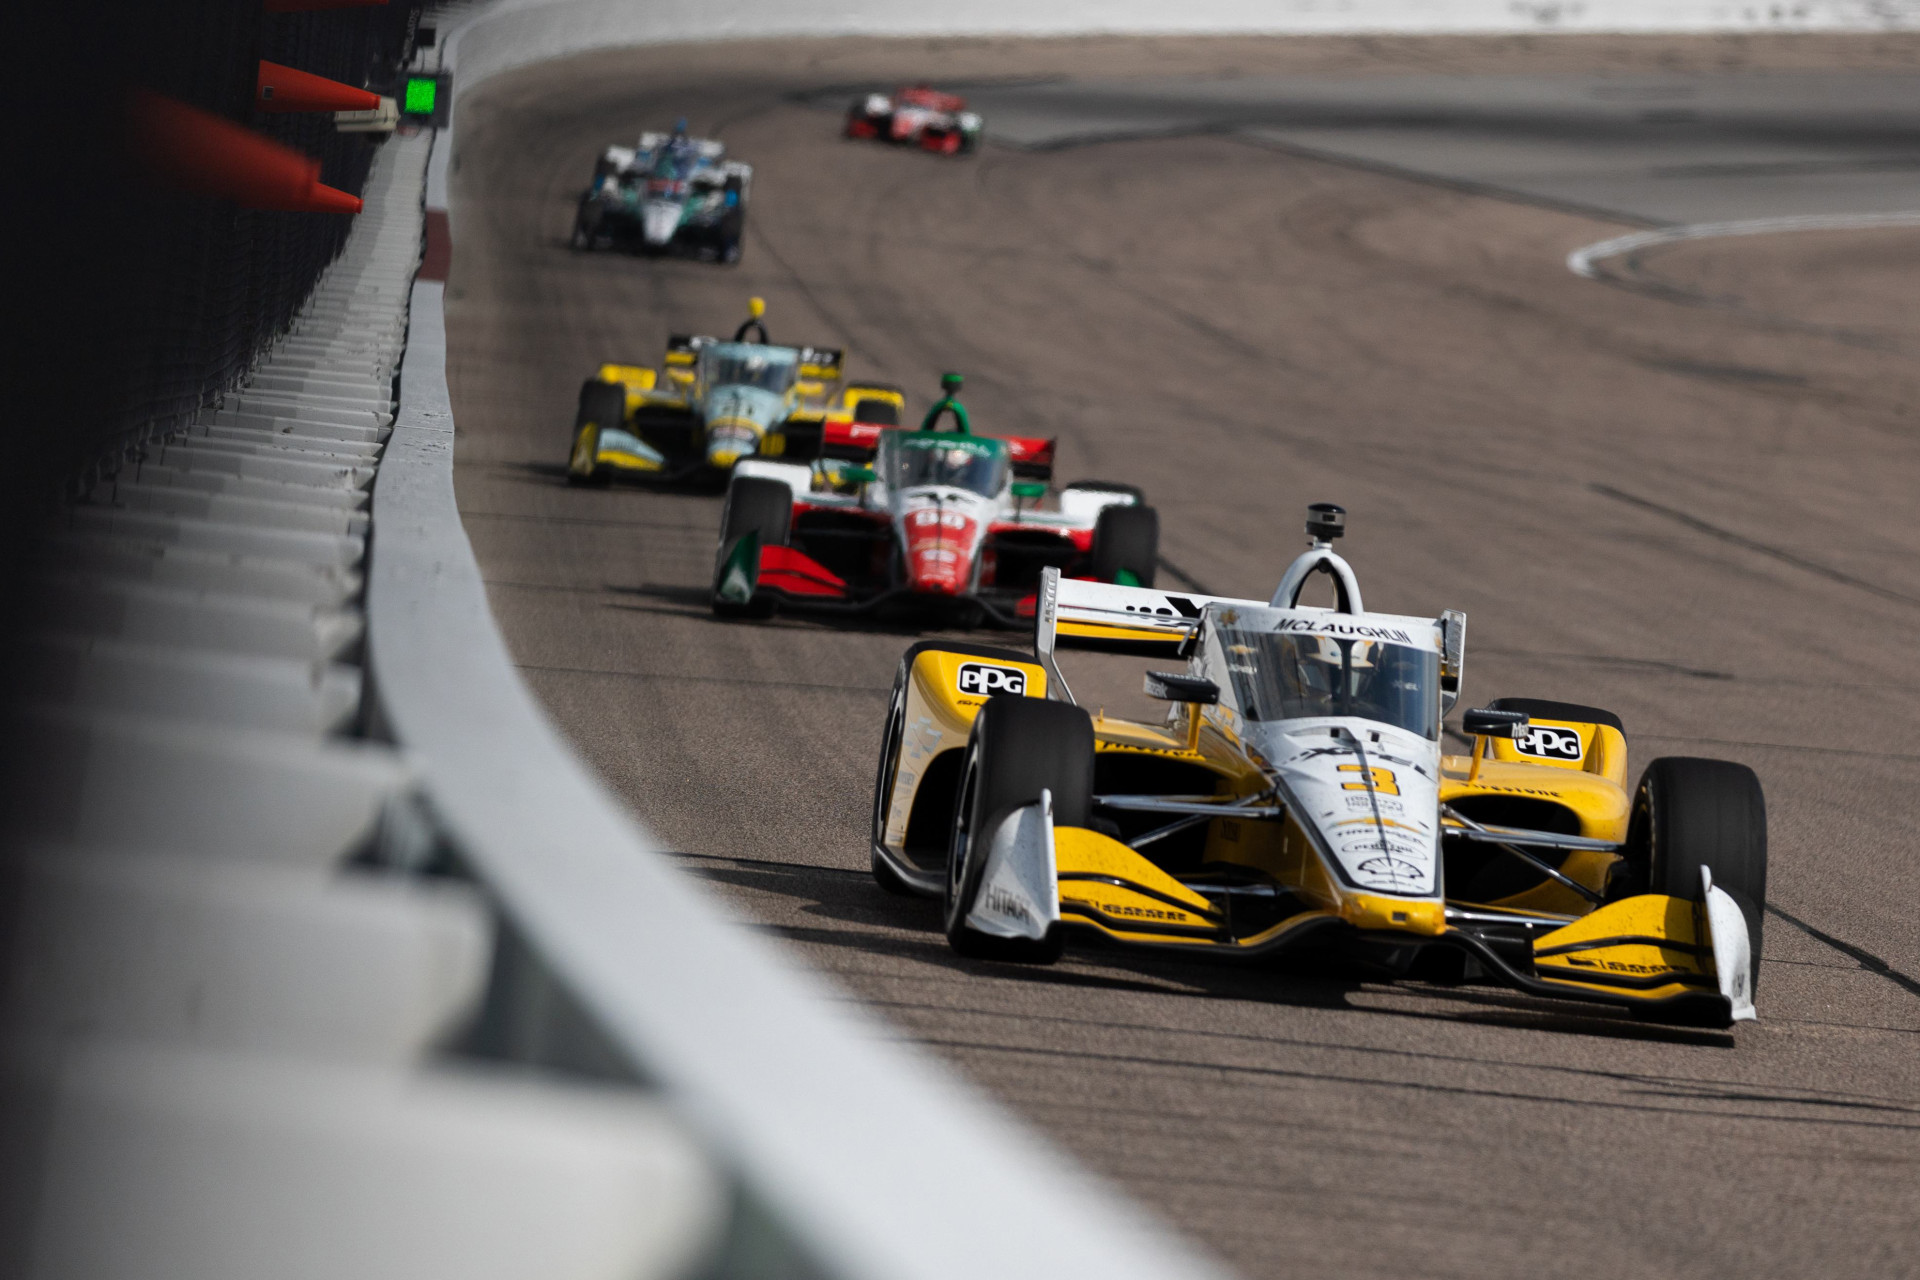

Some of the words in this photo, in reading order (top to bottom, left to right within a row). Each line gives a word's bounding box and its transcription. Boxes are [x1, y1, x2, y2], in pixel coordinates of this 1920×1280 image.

[1273, 617, 1414, 645] MCLAUGHLIN
[961, 667, 1022, 694] PPG
[1518, 729, 1578, 756] PPG
[1336, 763, 1401, 796] 3
